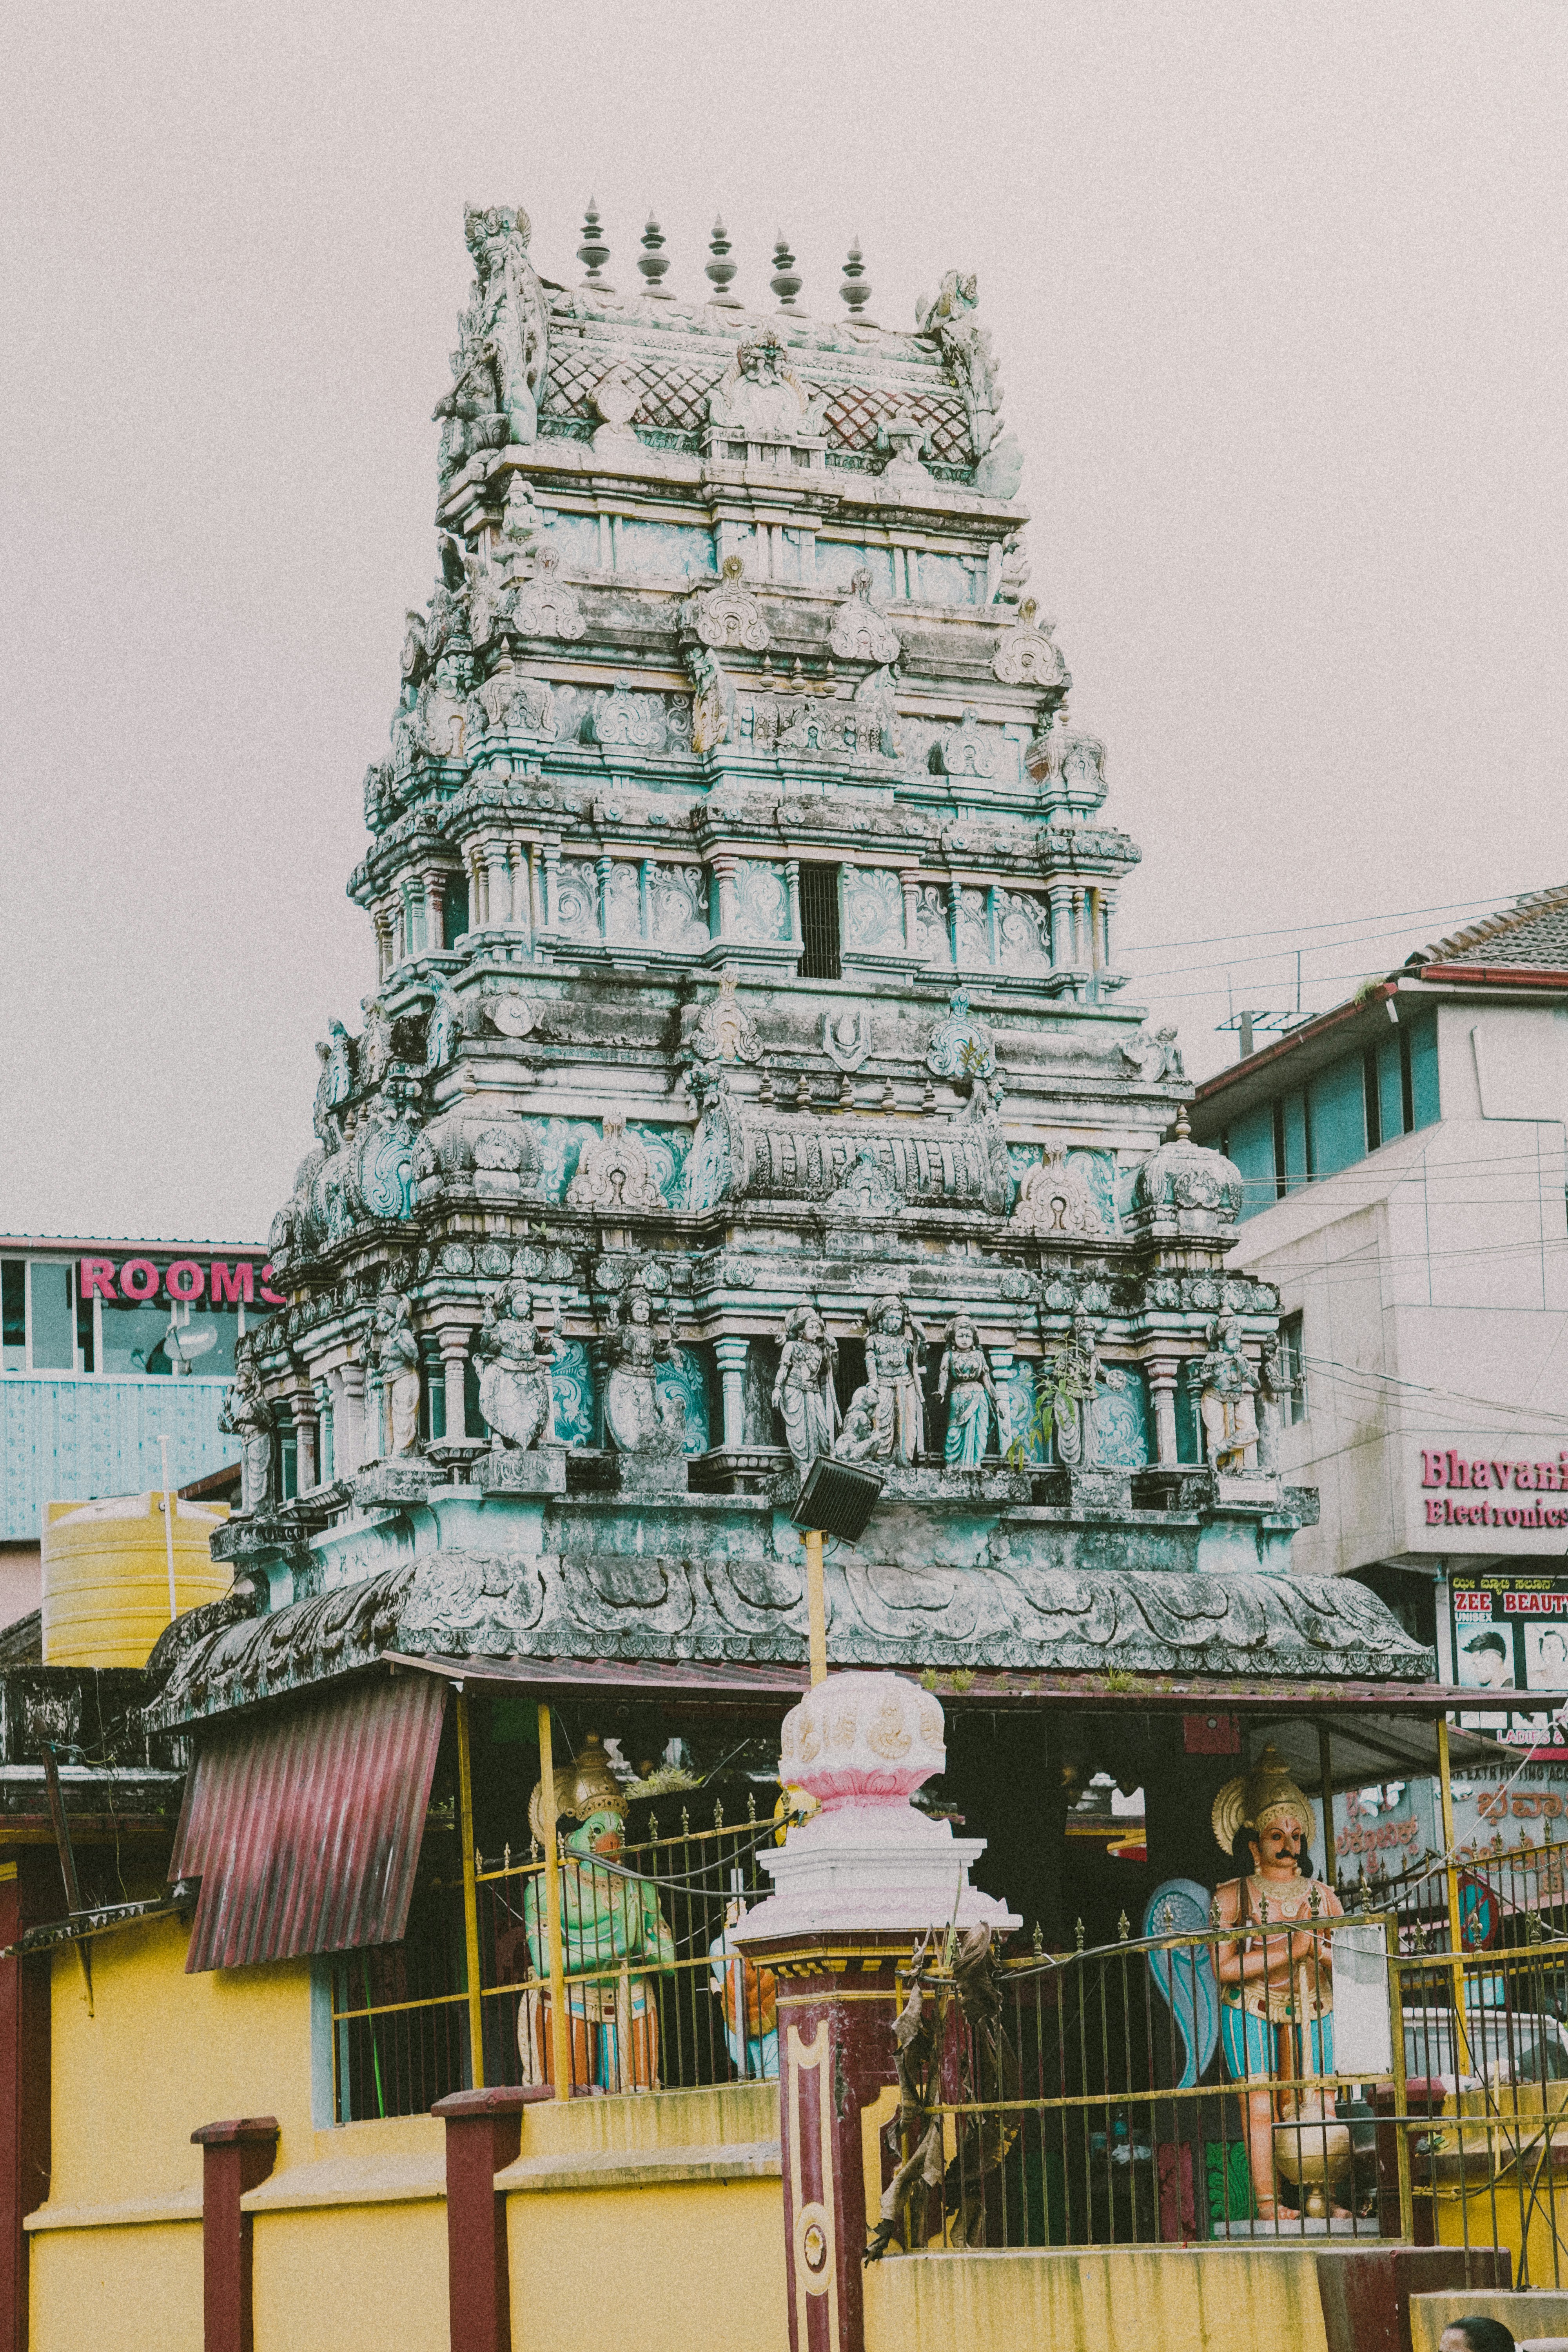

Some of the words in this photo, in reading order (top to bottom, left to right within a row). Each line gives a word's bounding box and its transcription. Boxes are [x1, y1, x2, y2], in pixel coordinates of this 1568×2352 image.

[1421, 1450, 1568, 1490] Bhavani
[1425, 1498, 1568, 1528] Electronics
[1454, 1592, 1492, 1612] ZEE
[1454, 1612, 1492, 1622] UNISEX
[1496, 1729, 1550, 1744] LADIES
[1477, 1784, 1568, 1826] ಭವಾ
